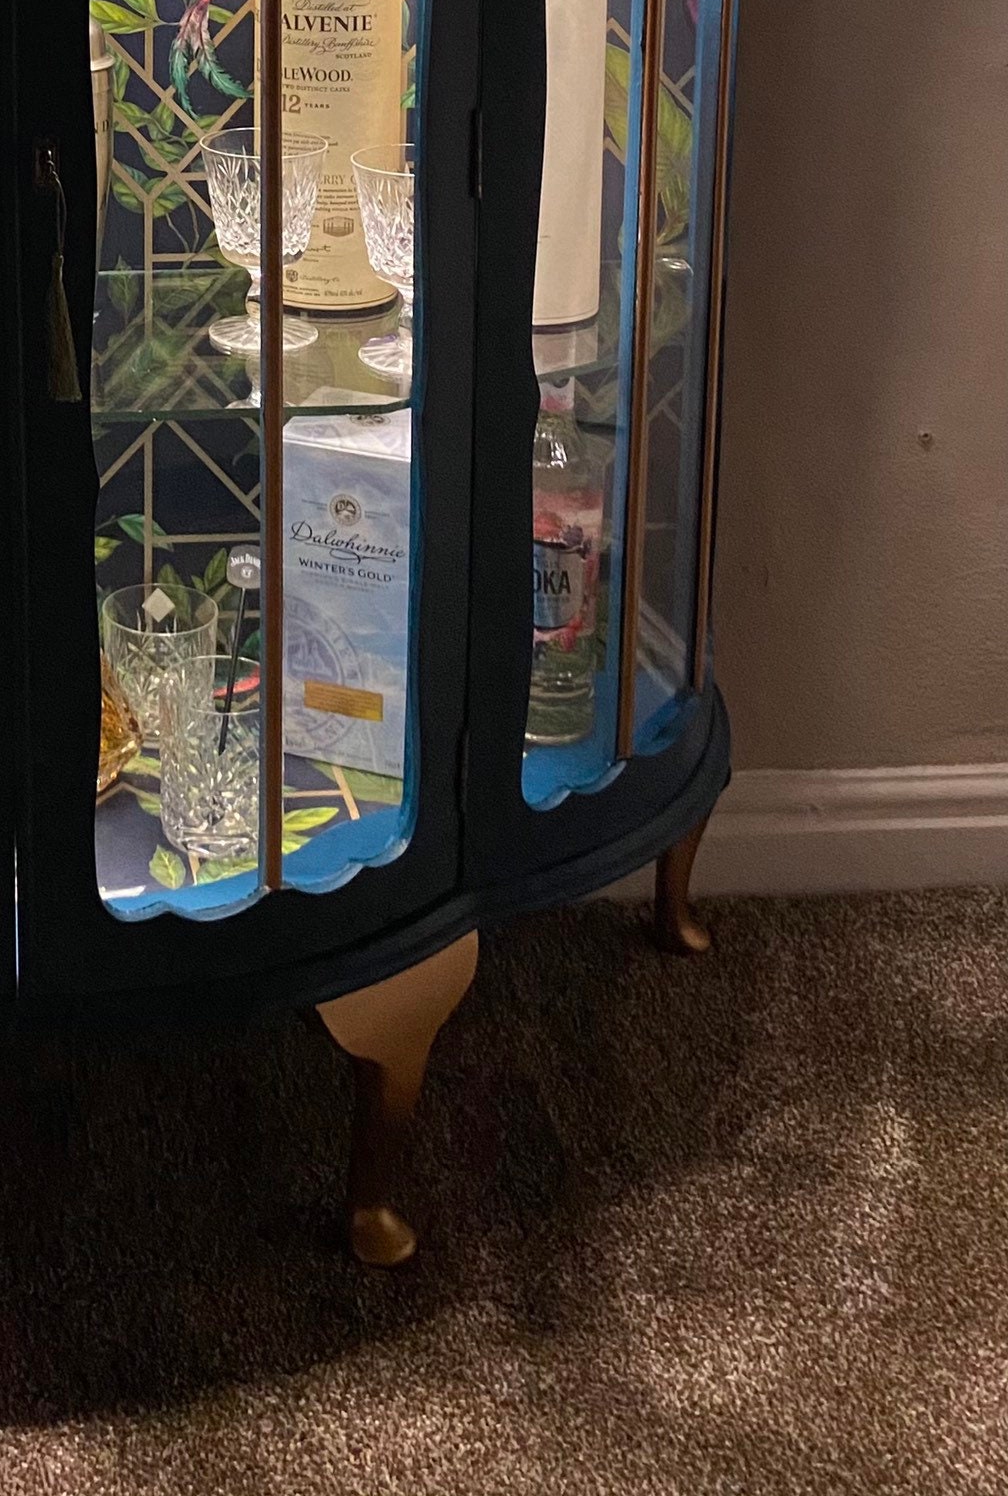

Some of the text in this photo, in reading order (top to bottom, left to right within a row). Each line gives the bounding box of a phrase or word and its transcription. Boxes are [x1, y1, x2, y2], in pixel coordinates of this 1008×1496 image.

[281, 14, 373, 33] ALVENIE
[281, 94, 301, 114] 12
[289, 520, 406, 564] Dalwhinnie
[357, 569, 392, 583] GOLD
[533, 569, 571, 595] DKA
